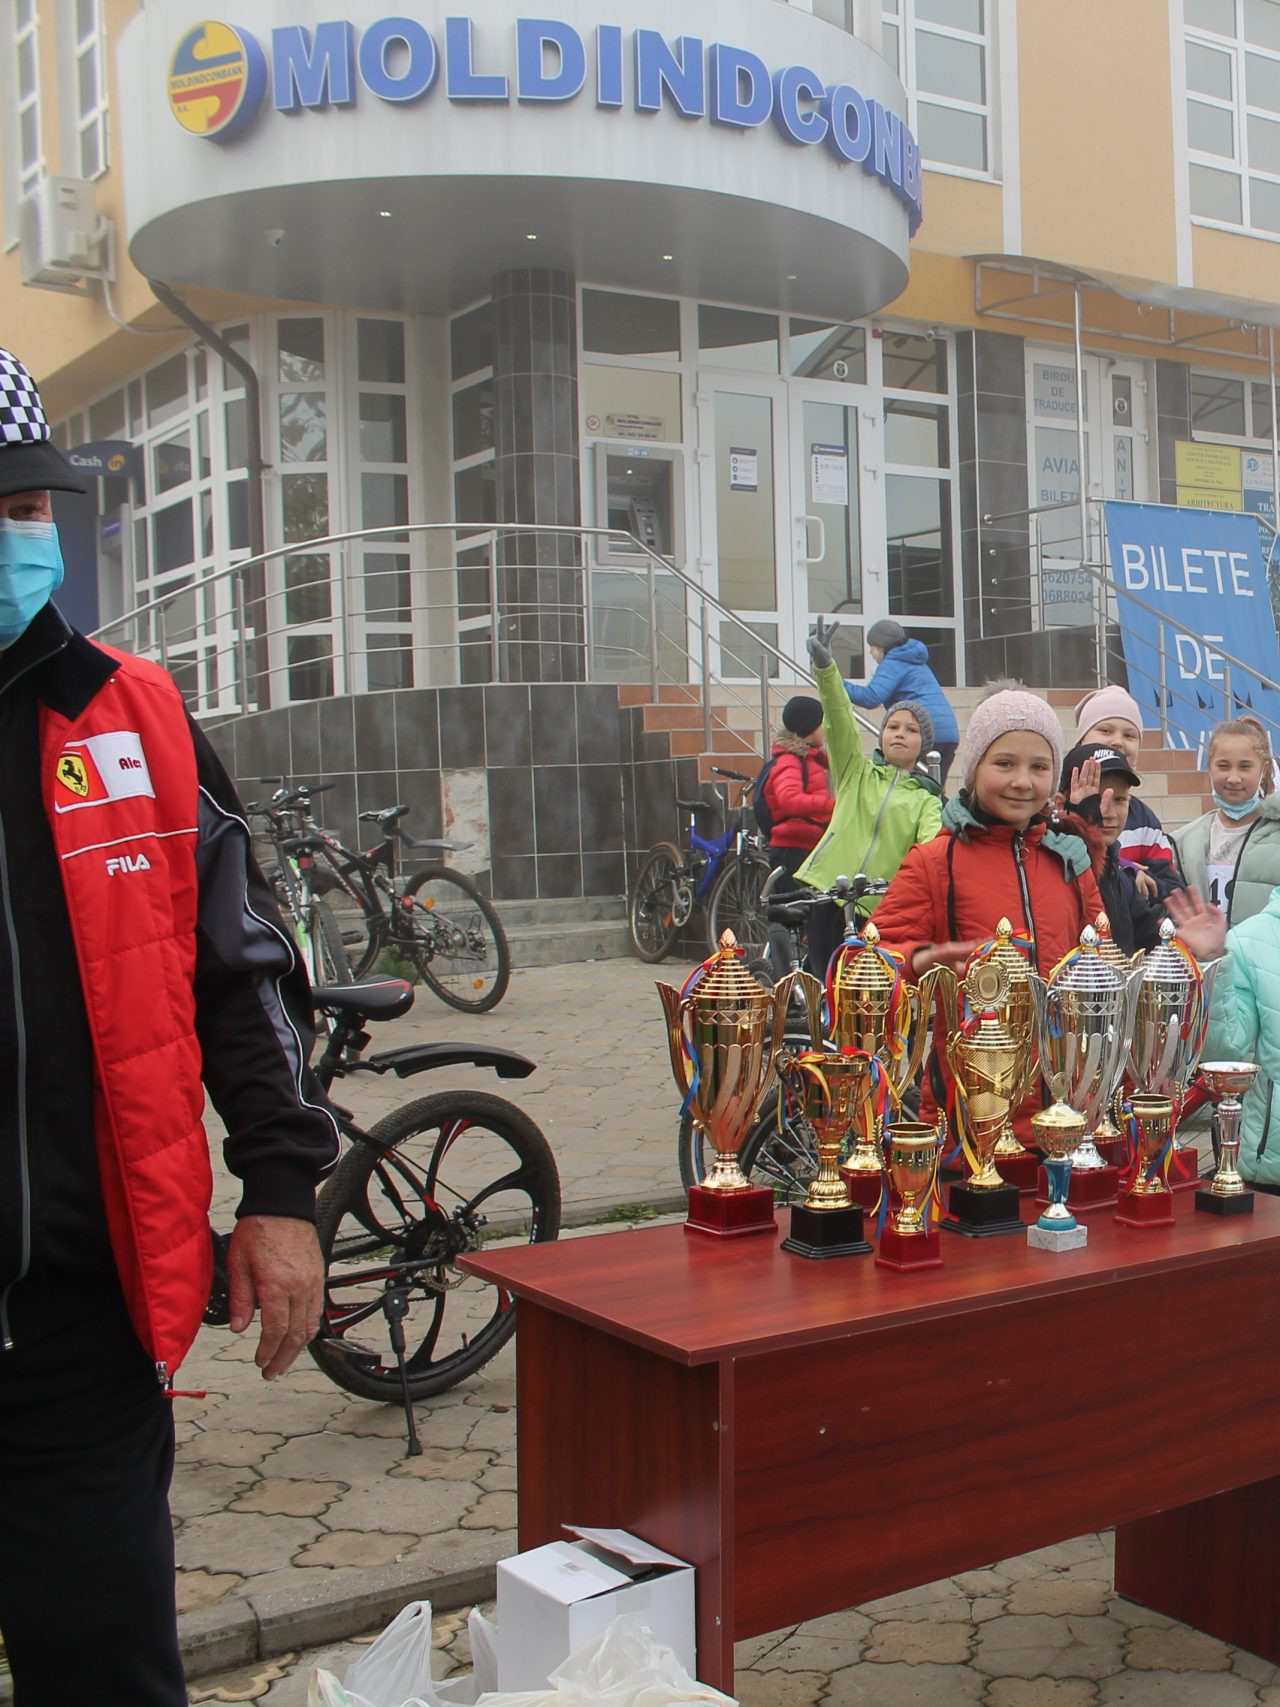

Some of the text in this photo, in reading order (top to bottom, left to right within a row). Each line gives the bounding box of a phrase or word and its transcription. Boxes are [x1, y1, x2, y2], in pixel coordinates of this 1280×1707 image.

[271, 17, 922, 220] MOLDINDCONB
[1043, 370, 1075, 383] BIROU
[1051, 387, 1065, 398] DE
[69, 454, 102, 467] Cash
[1122, 544, 1254, 597] BILETE
[1175, 634, 1226, 680] DE
[1093, 749, 1115, 759] NIKE
[105, 853, 151, 877] FILA
